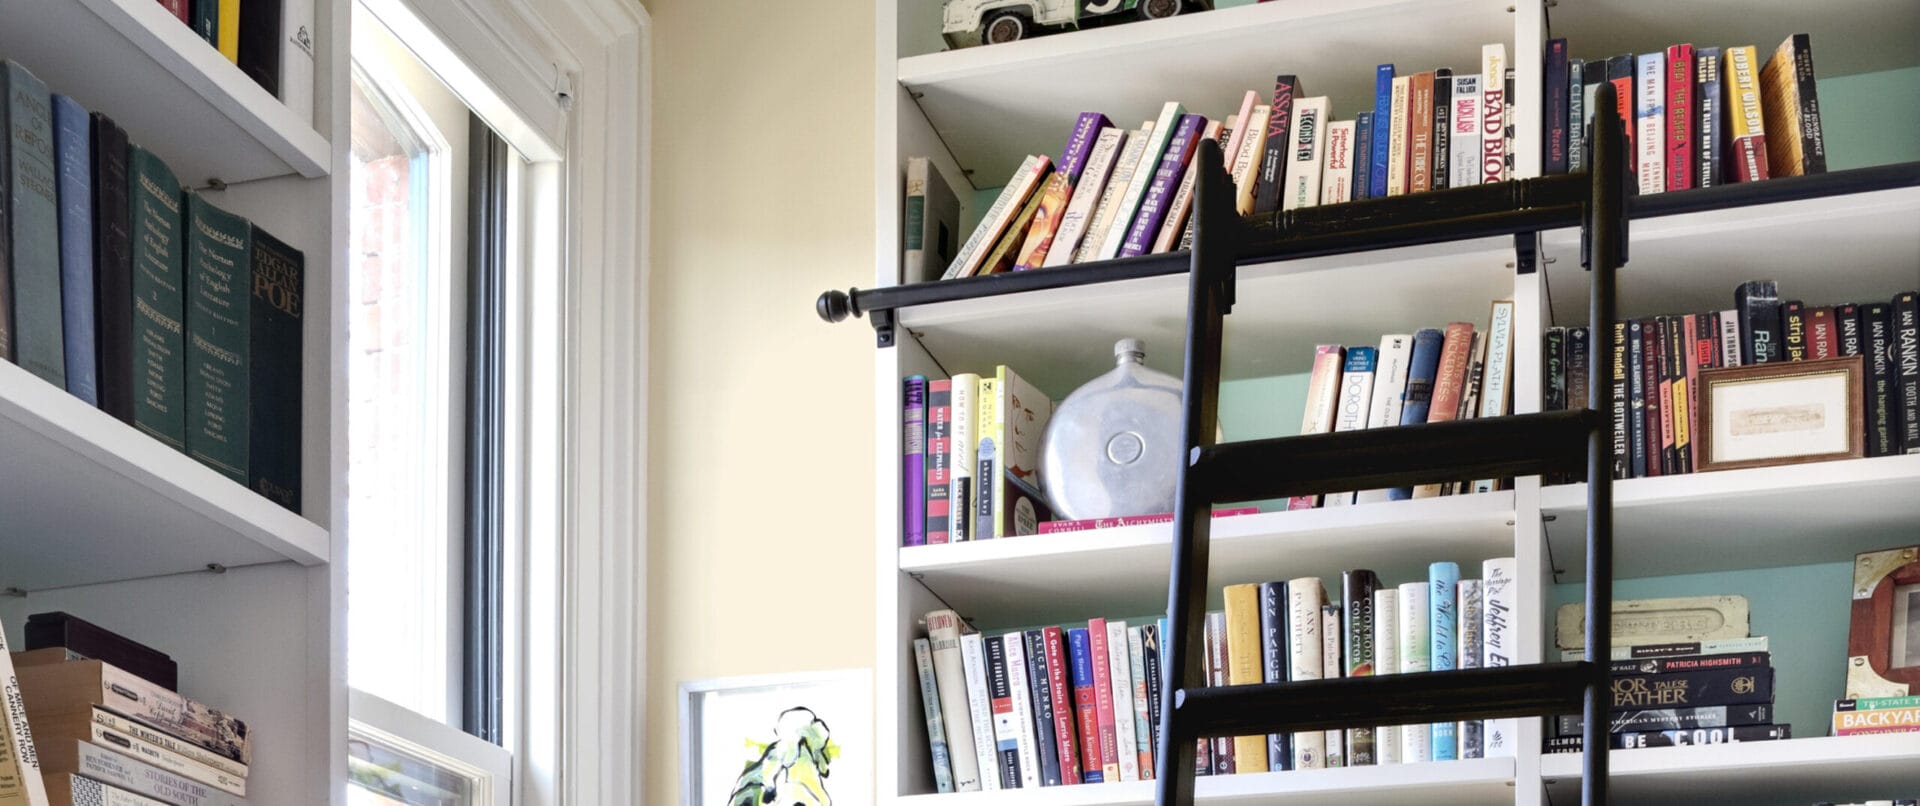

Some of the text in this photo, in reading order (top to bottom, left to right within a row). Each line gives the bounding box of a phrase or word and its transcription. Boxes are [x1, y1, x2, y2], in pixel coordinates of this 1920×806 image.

[1698, 55, 1706, 82] WILSON
[1707, 55, 1715, 81] ROBERT
[1796, 53, 1806, 82] WILSON
[1801, 47, 1811, 77] ROBERT
[1456, 78, 1477, 86] SUSAN
[1456, 86, 1477, 95] FALUDI
[1484, 56, 1502, 134] Jones BAD
[1733, 47, 1762, 136] ROBERT WILSON
[1267, 81, 1292, 140] ASSATA
[1646, 60, 1655, 156] THE MAN FROM BEIJING
[1674, 60, 1685, 140] BEAT THE REAPER
[1456, 98, 1474, 132] BACKLASH
[1569, 82, 1581, 172] CLIVE BARKER
[1702, 97, 1711, 160] THE BLIND MAN OF
[1803, 112, 1814, 140] BLOOD
[1809, 98, 1823, 157] THE IGNORANCE
[1332, 127, 1339, 135] is
[1415, 131, 1427, 152] THE
[1551, 128, 1562, 161] Dracula
[1743, 136, 1752, 150] THE
[1328, 135, 1341, 169] Powerful
[1337, 127, 1350, 169] Sisterhood
[1652, 161, 1660, 193] HENNING
[207, 248, 235, 268] Norton
[255, 246, 298, 281] EDGAR
[207, 275, 231, 295] English
[255, 263, 298, 293] ALLAN
[252, 271, 301, 319] POE
[1725, 320, 1735, 333] JIM
[1786, 315, 1802, 343] strip
[1815, 323, 1826, 339] IAN
[1843, 318, 1856, 335] IAN
[1489, 307, 1507, 391] SYLVIA PLATH
[1549, 335, 1560, 355] Joe
[1574, 342, 1582, 367] ALAN
[1659, 333, 1667, 376] THOMPSON
[1673, 333, 1681, 376] THOMPSON
[1700, 339, 1709, 363] FISHER
[1753, 329, 1769, 362] Ran
[1767, 342, 1776, 356] Ian
[1872, 321, 1885, 375] IAN RANKIN
[1437, 326, 1461, 403] WICKEDNESS
[1451, 329, 1469, 393] THE TENTS OF
[1644, 339, 1655, 401] RUTH RENDELL
[1900, 310, 1918, 441] IAN RANKIN TOOTH AND NAIL
[1613, 323, 1624, 455] Ruth Rendell THE ROTTWEILER
[1632, 364, 1640, 394] SLAUGHTER
[957, 411, 963, 423] TO
[1339, 374, 1365, 431] DOROTH
[1875, 379, 1888, 453] the hanging garden
[936, 407, 944, 430] WATER
[956, 425, 963, 436] BE
[935, 441, 943, 480] ELEPHANTS
[980, 498, 989, 515] boy
[1095, 518, 1114, 529] THE
[1491, 567, 1503, 578] The
[1265, 586, 1277, 617] ANN
[1435, 579, 1451, 650] the World to
[1294, 592, 1302, 656] PATCHETT
[1306, 608, 1314, 634] ANN
[1351, 600, 1361, 664] COLLECTOR
[1362, 597, 1373, 664] COOKBOOK
[1485, 599, 1510, 649] Jeffrey
[991, 640, 1000, 659] SUITE
[1007, 636, 1019, 658] Alice
[1049, 639, 1058, 657] Gate
[1074, 634, 1082, 647] Pigs
[1326, 622, 1336, 666] Ann Patchett
[1009, 659, 1023, 686] Munro
[1034, 634, 1050, 719] ALICE MUNRO
[1052, 658, 1058, 667] at
[1053, 668, 1061, 680] the
[1094, 633, 1108, 710] THE BEAN TREES
[1149, 657, 1157, 690] GERALDINE
[1666, 655, 1742, 669] PATRICIA HIGHSMITH
[1055, 682, 1064, 704] Stairs
[1613, 688, 1688, 706] FATHER
[1655, 680, 1689, 691] TALESE
[5, 685, 24, 736] CANNERY
[18, 738, 30, 764] ROW
[10, 676, 39, 769] OF MICE AND MEN
[1059, 716, 1068, 739] Lorrie
[1610, 717, 1648, 725] AMERICAN
[1650, 715, 1684, 723] MYSTERY
[1685, 713, 1717, 721] STORIES
[128, 725, 176, 750] THE TALE
[1062, 739, 1071, 762] Moore
[1083, 708, 1097, 770] Barbara Kingsolver
[1625, 728, 1741, 749] BE COOL
[144, 769, 207, 798] STORIES OF THE
[154, 784, 171, 798] OLD
